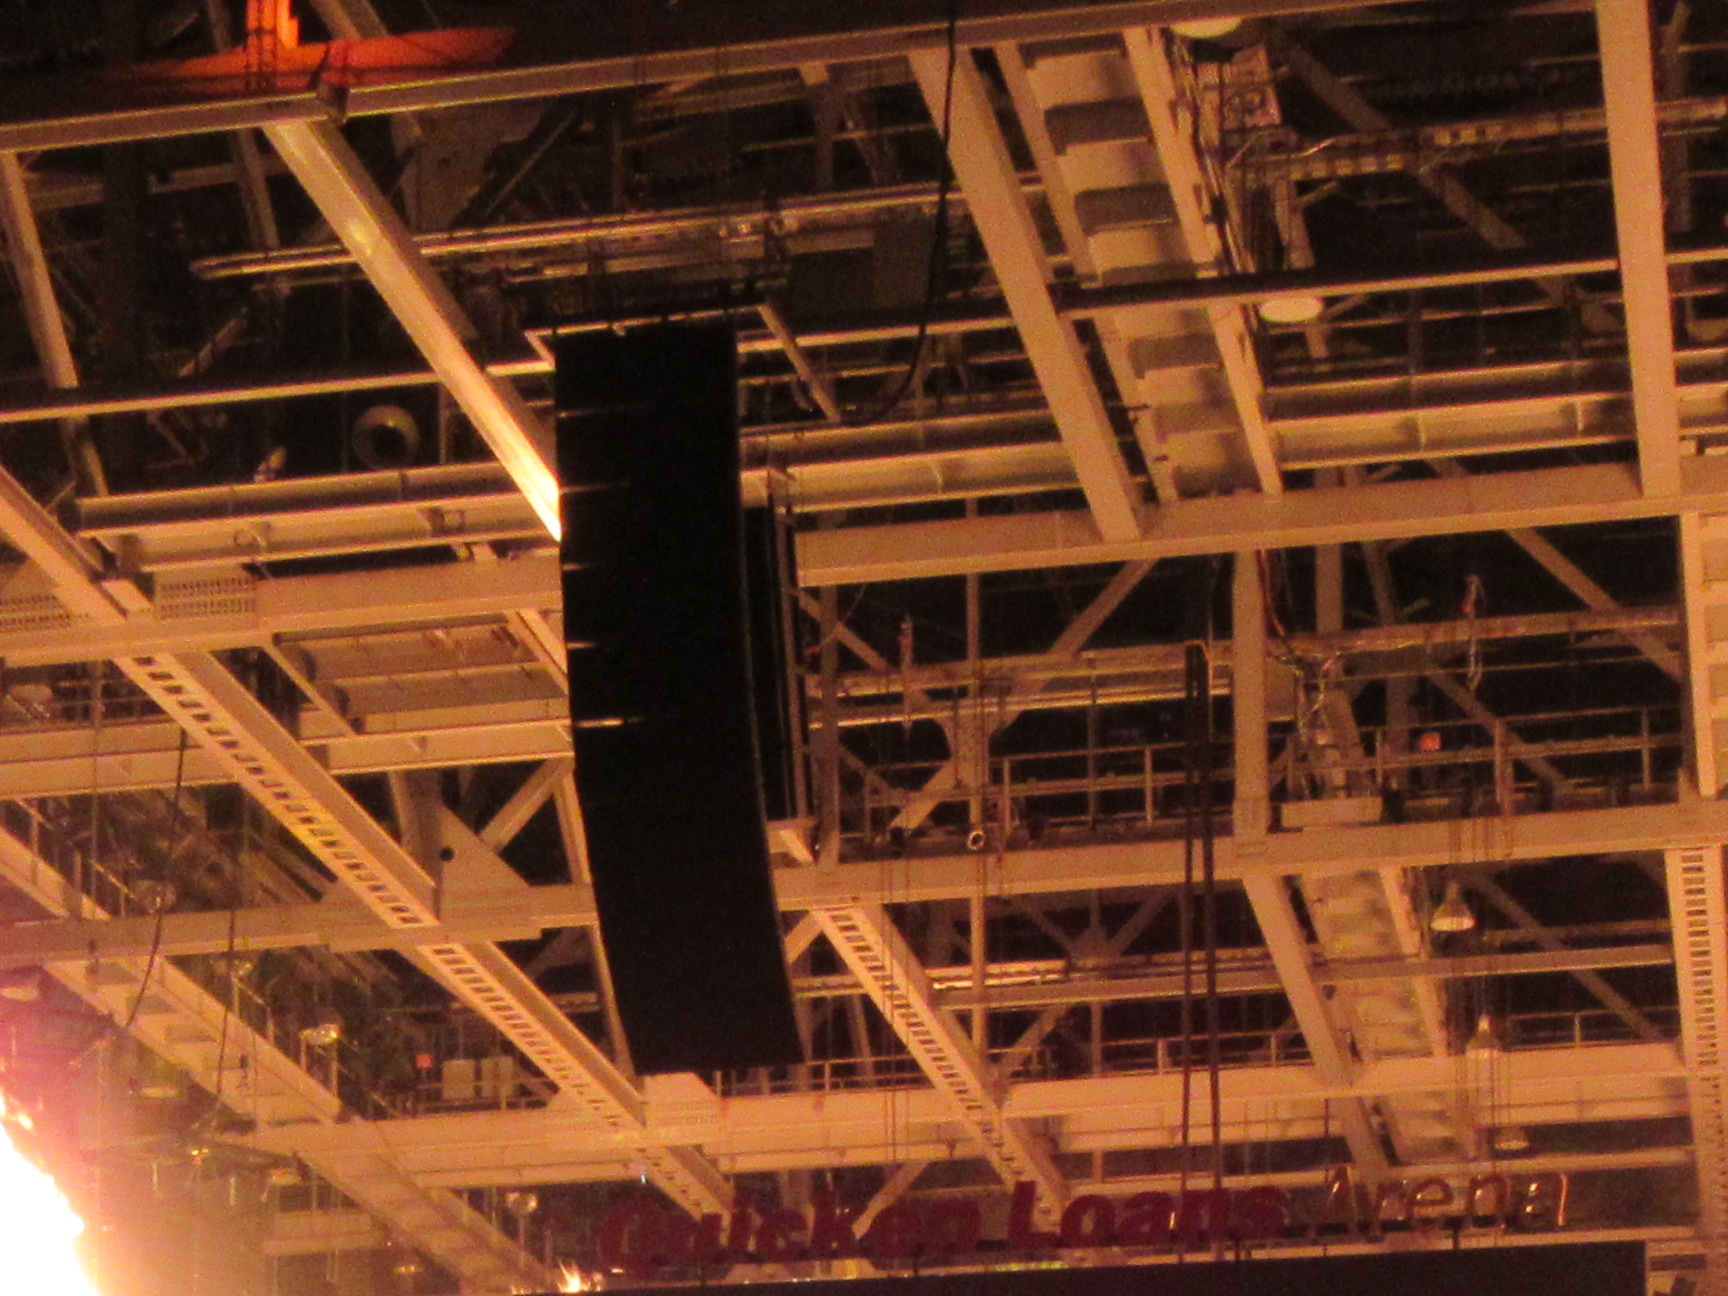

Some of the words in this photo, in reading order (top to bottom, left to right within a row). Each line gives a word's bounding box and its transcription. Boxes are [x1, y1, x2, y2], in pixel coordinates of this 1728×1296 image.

[598, 1186, 981, 1272] Quicken
[1008, 1180, 1289, 1249] Loans
[1314, 1164, 1571, 1242] Arena
